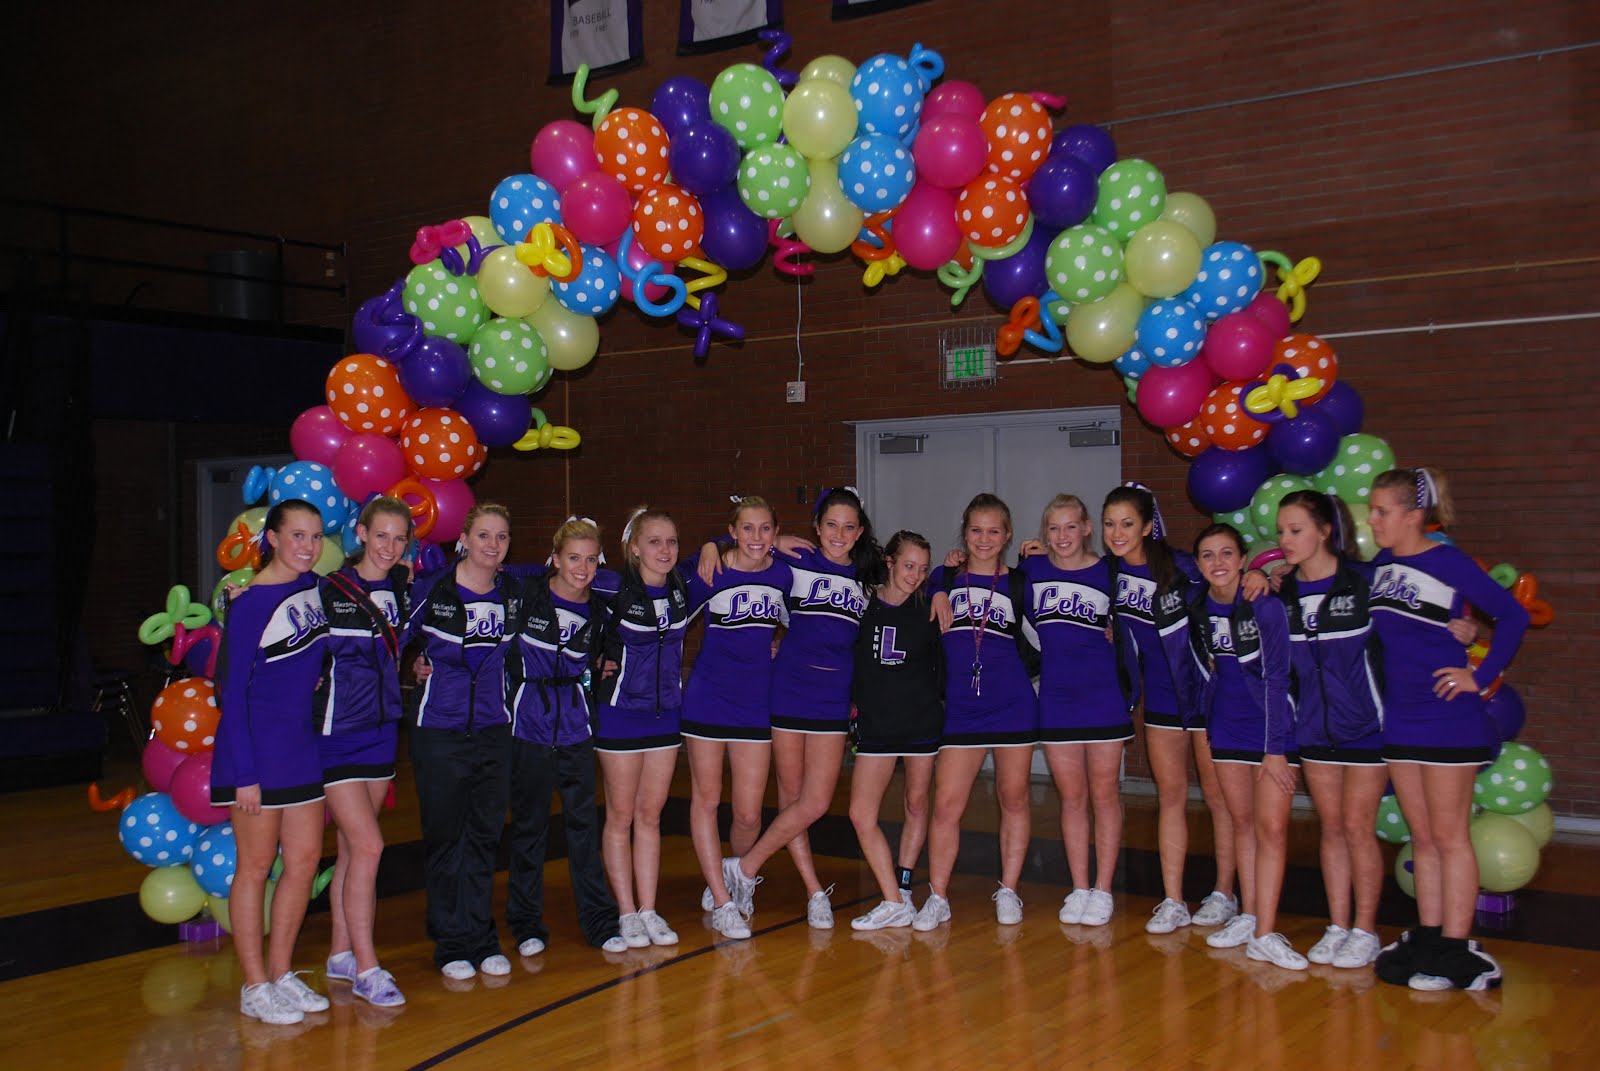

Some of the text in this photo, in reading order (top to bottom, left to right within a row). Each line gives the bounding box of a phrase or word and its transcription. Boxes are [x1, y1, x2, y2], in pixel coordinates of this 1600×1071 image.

[955, 348, 984, 377] EXIT
[721, 591, 781, 623] Lehi
[799, 577, 864, 618] Lehi
[1034, 586, 1098, 623] Lehi
[1369, 569, 1421, 609] Lehi
[287, 602, 328, 647] Leh
[950, 592, 1008, 628] Lehi
[880, 625, 907, 661] L
